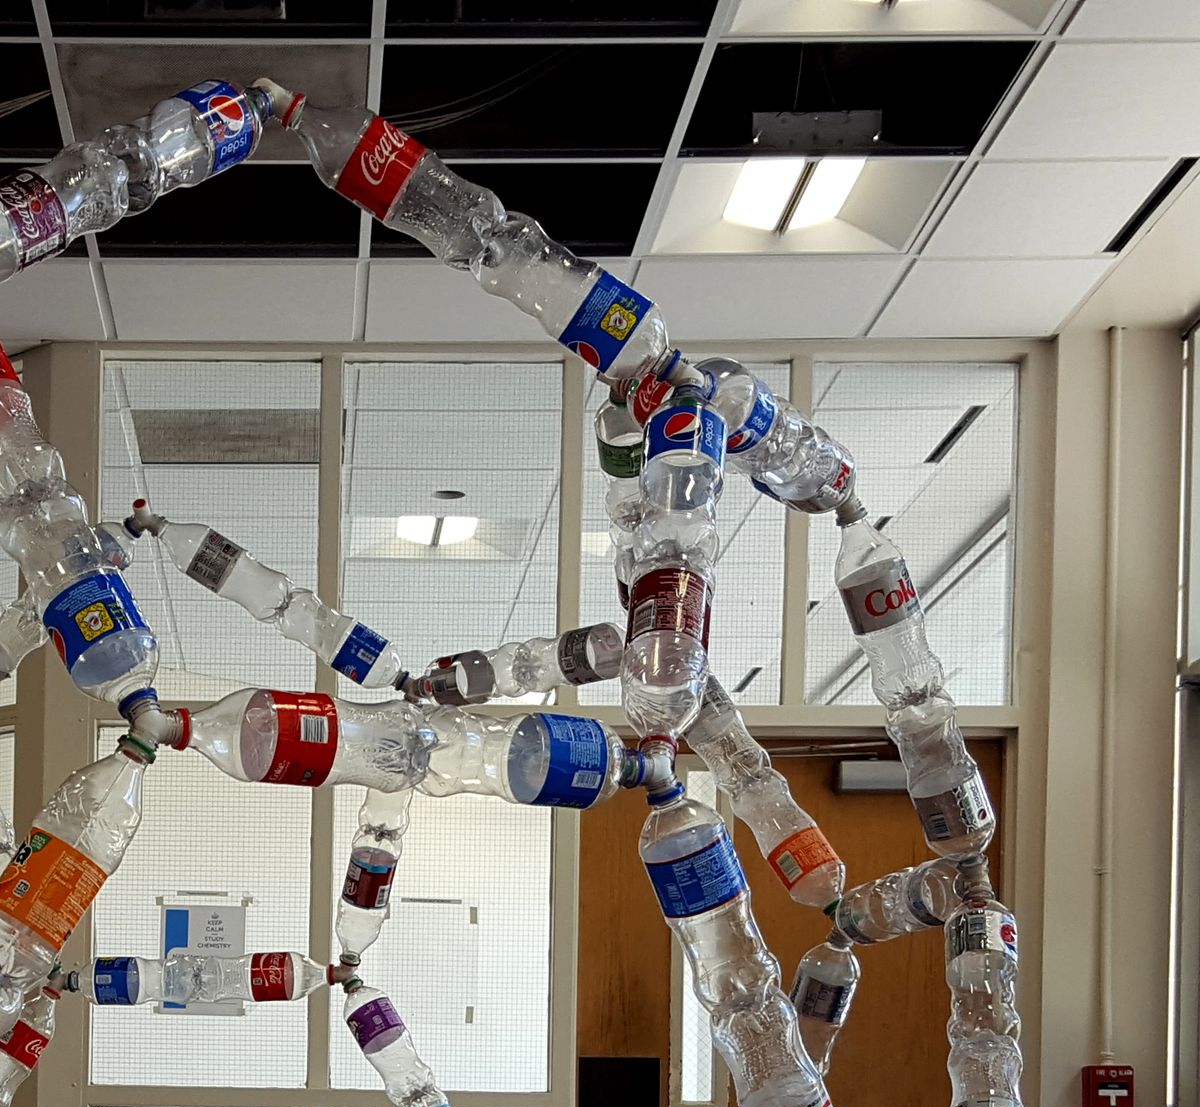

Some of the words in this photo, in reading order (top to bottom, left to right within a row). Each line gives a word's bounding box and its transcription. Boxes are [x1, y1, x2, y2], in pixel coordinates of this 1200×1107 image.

[220, 133, 247, 159] pepsi
[704, 417, 714, 448] pepsi
[865, 579, 916, 616] Cok
